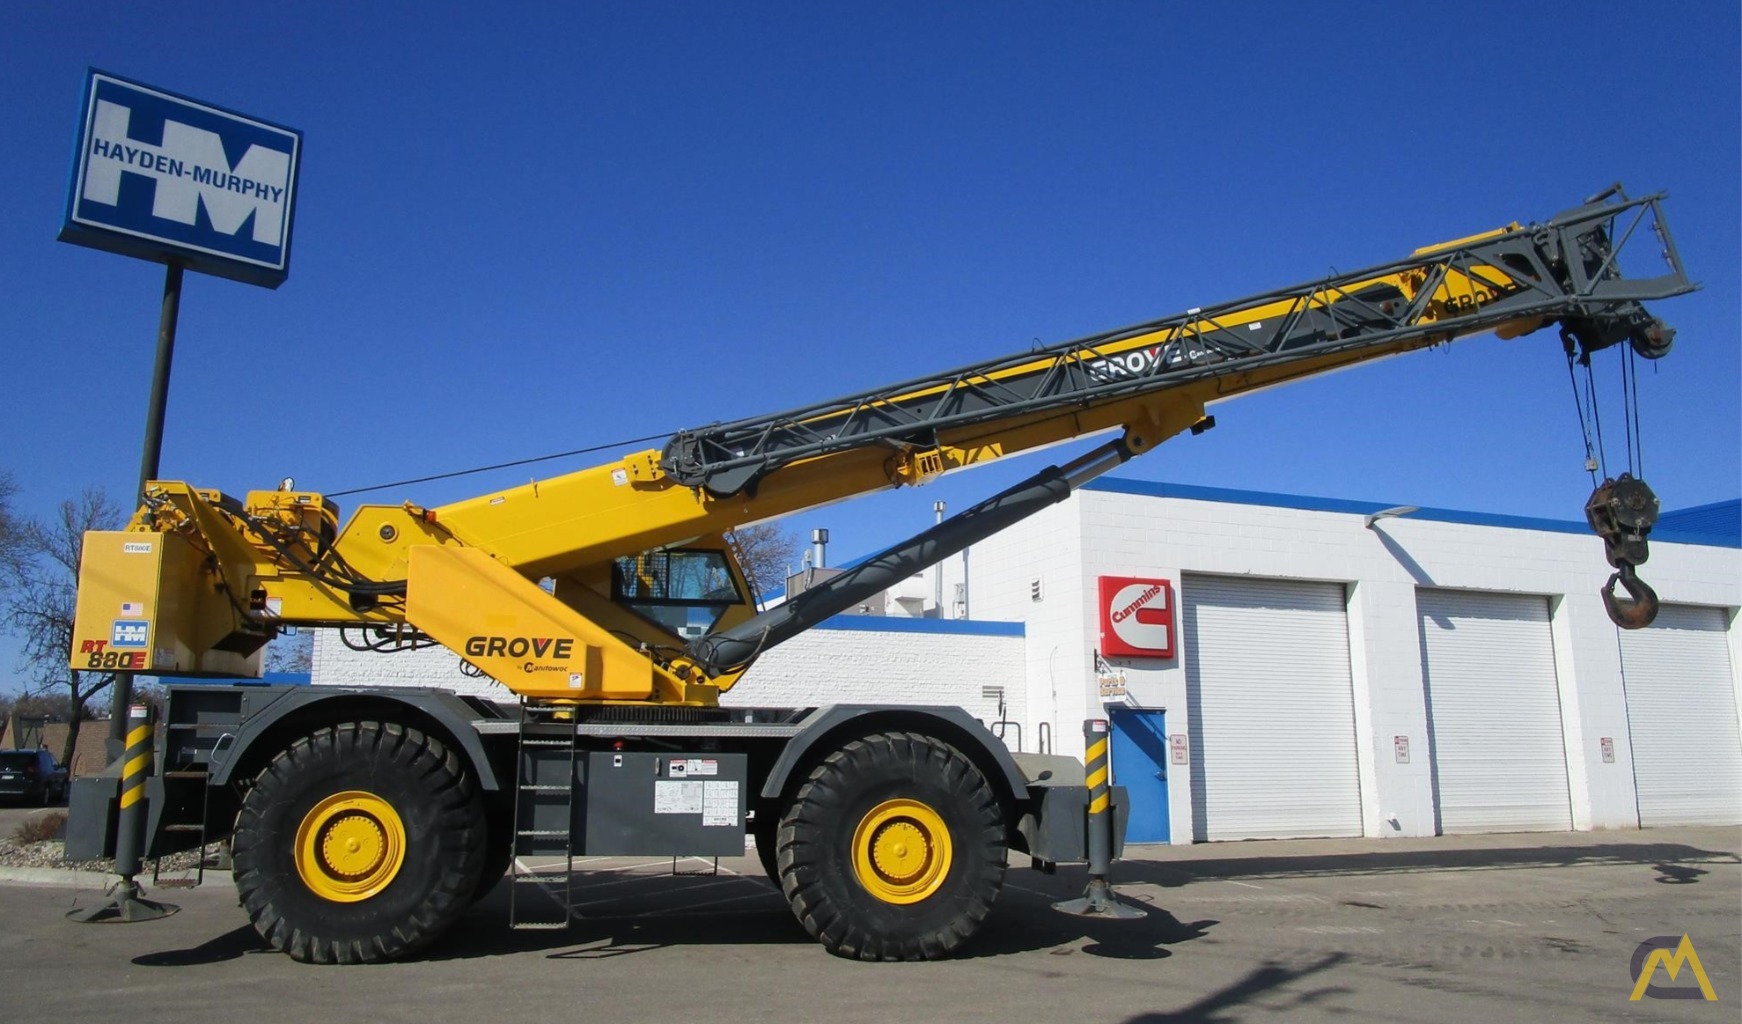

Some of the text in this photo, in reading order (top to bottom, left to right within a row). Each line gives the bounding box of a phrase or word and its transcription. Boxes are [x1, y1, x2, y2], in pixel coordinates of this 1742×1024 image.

[93, 138, 283, 203] HAYDEN-MURPHY
[1112, 584, 1161, 624] Cummins
[114, 625, 147, 642] HM
[80, 640, 108, 653] RT
[465, 636, 574, 659] GROVE
[87, 652, 147, 669] 880E
[524, 662, 568, 673] Manitowoc
